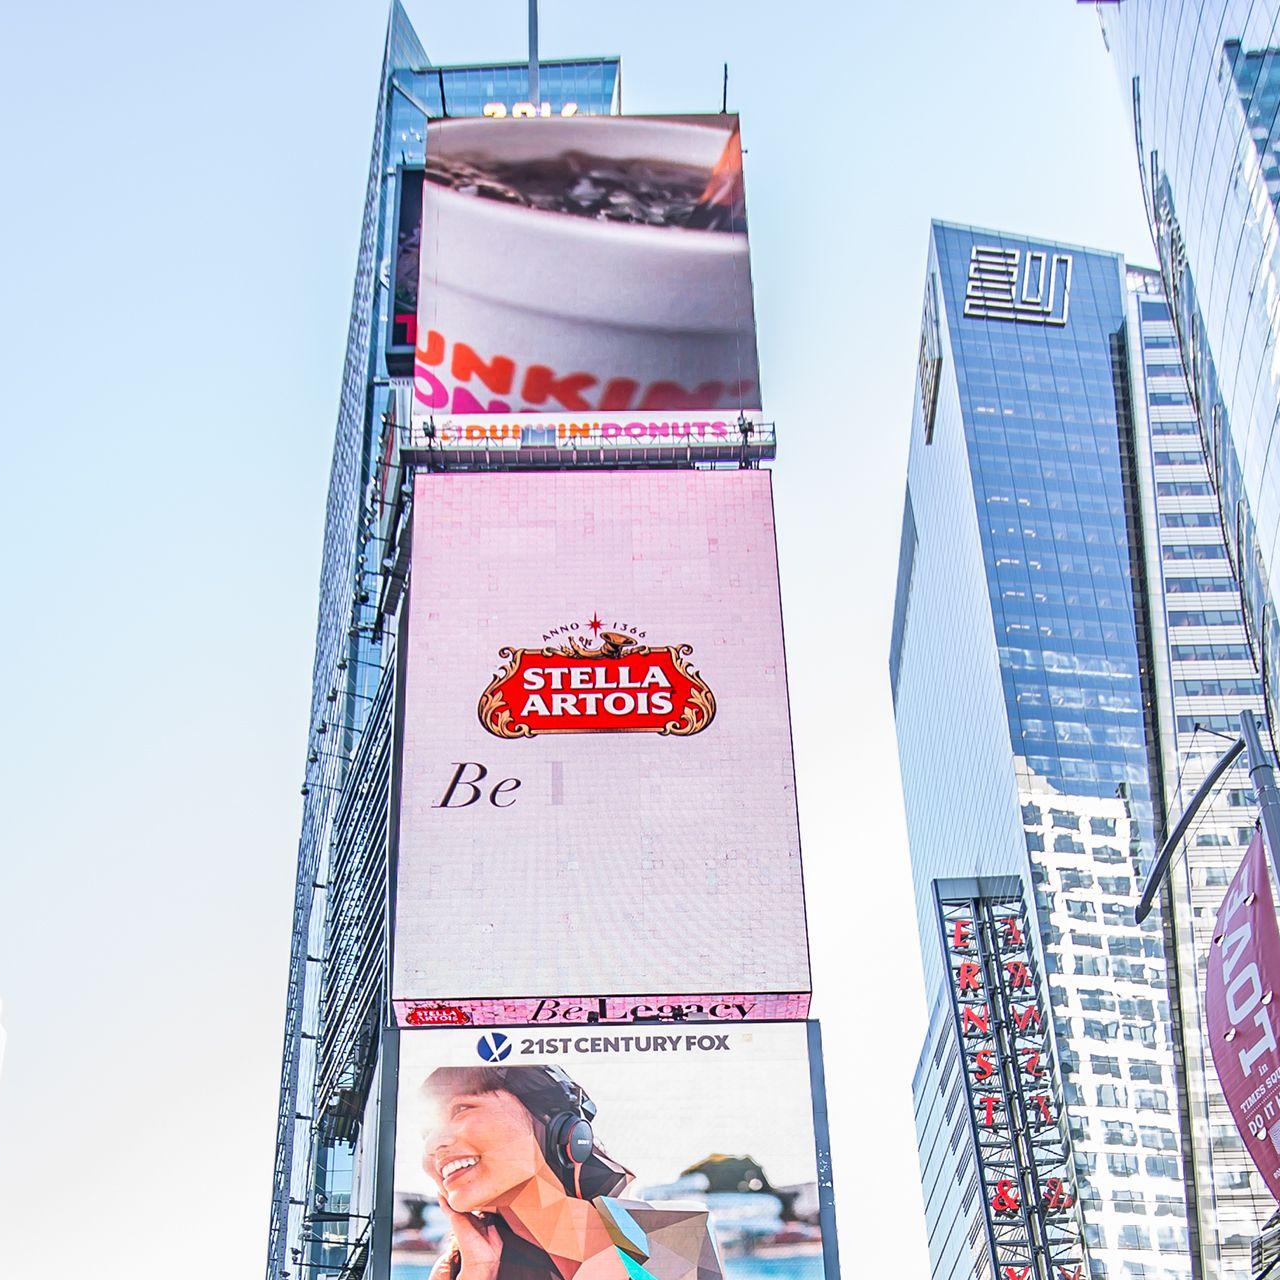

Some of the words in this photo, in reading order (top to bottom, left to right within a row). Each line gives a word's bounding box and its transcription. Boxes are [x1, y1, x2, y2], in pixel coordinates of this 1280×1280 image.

[465, 421, 599, 441] DUIN'
[600, 421, 728, 439] DONUTS
[542, 622, 580, 642] ANNO
[613, 621, 647, 638] 1366
[522, 665, 672, 690] STELLA
[519, 691, 674, 717] ARTOIS
[430, 761, 522, 809] Be
[529, 999, 584, 1022] Be
[520, 1037, 573, 1055] 21ST
[574, 1035, 682, 1054] CENTURY
[685, 1034, 731, 1051] FOX
[952, 917, 1002, 1127] ERNST
[991, 1177, 1021, 1213] &
[1240, 1084, 1267, 1113] TIMES
[1248, 1114, 1264, 1137] DO
[1264, 1102, 1276, 1120] IT
